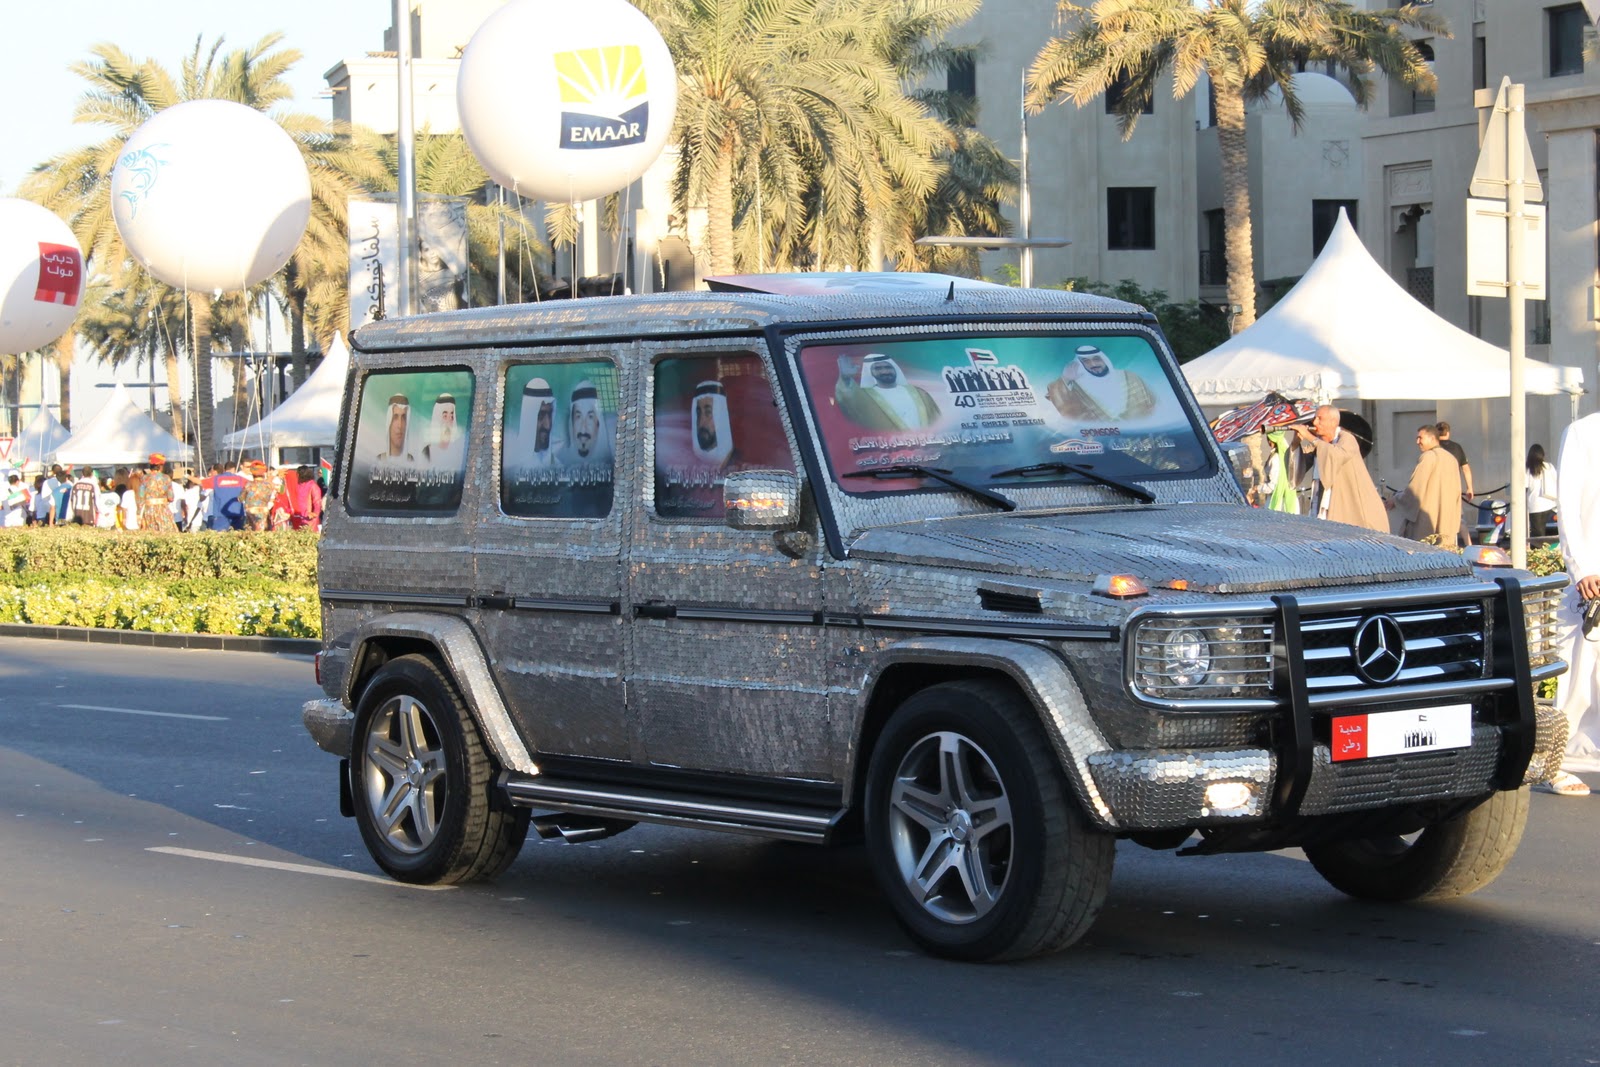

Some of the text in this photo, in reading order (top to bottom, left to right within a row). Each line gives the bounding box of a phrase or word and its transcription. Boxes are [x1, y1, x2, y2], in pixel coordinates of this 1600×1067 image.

[570, 122, 641, 142] EMAAR
[42, 252, 74, 265] دبي
[955, 395, 976, 408] 40
[1012, 418, 1045, 426] DESIGN
[1080, 427, 1120, 437] SPONSORS
[76, 489, 90, 511] 11
[1338, 724, 1362, 734] هدية
[1341, 739, 1361, 752] وطن
